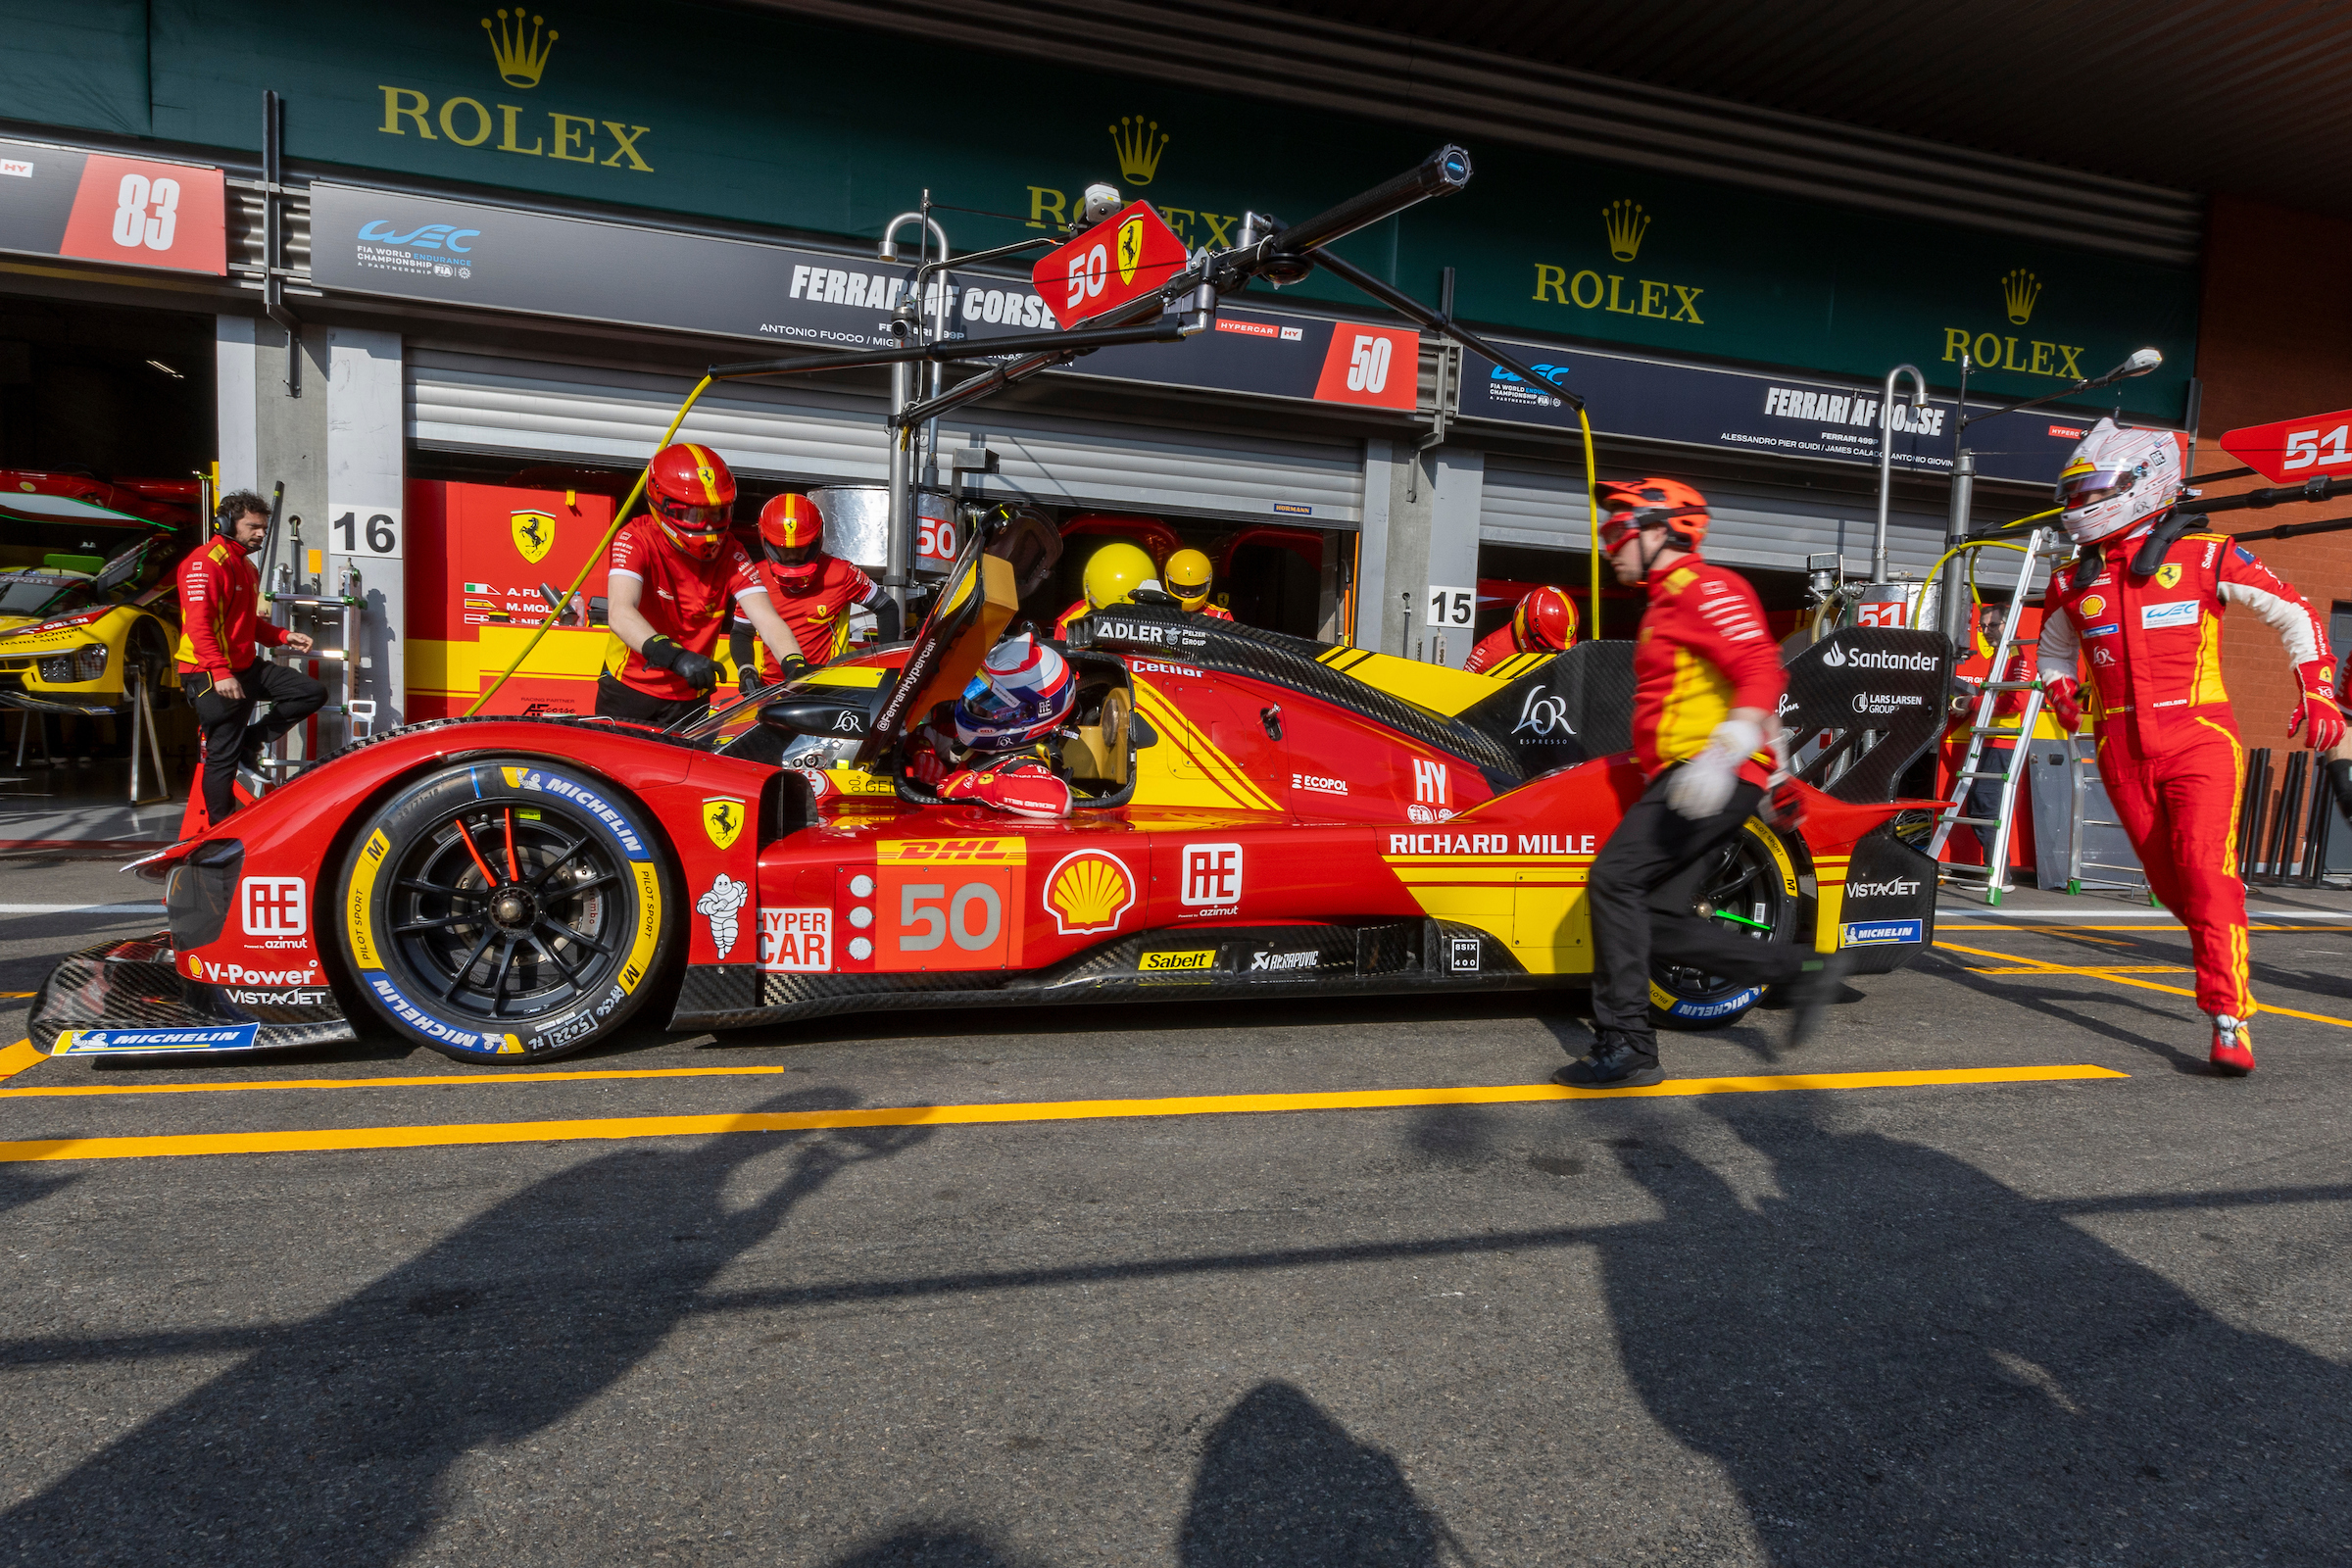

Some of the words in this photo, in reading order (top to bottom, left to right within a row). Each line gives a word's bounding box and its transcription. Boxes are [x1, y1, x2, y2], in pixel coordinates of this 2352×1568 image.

[378, 84, 655, 172] ROLEX
[4, 163, 27, 172] HY
[112, 173, 180, 251] 83
[1025, 185, 1239, 253] REX
[357, 220, 481, 253] WEC
[357, 245, 373, 254] FIA
[375, 247, 412, 259] WORLD
[413, 253, 471, 267] ENDURANCE
[357, 253, 432, 269] CHAMPIONSHIP
[368, 263, 432, 274] PARTNERSHIP
[1066, 243, 1107, 310] 50
[1532, 263, 1705, 324] ROLEX
[924, 282, 960, 318] AF
[962, 287, 1056, 330] CORSE
[760, 323, 817, 338] ANTONIO
[820, 330, 864, 343] FUOCO
[878, 322, 933, 337] FEARI
[1220, 321, 1274, 335] HYPERCAR
[1347, 334, 1393, 394] 50
[1941, 327, 2085, 380] ROLEX
[1490, 389, 1538, 400] CHAMPIONSHIP
[1502, 384, 1525, 393] WORLD
[1764, 387, 1851, 424] FERRARI
[1849, 396, 1879, 427] AF
[1821, 432, 1857, 444] FERRARI
[1857, 436, 1879, 446] 499P
[2051, 428, 2080, 437] HYPERC
[1721, 432, 1777, 447] ALESSANDRO
[1778, 439, 1797, 449] PIER
[1797, 440, 1821, 451] GUIDI
[1825, 444, 1852, 455] JAMES
[1890, 453, 1927, 464] ANTONIO
[1927, 458, 1954, 467] GIOVIN
[2283, 424, 2352, 470] 51
[333, 512, 396, 554] 16
[916, 518, 956, 559] 50
[507, 587, 521, 597] A.
[506, 602, 521, 612] M.
[523, 604, 554, 613] MOL
[1432, 591, 1472, 624] 15
[1858, 604, 1902, 629] 51
[2146, 603, 2196, 618] WEC
[43, 617, 89, 630] ORLEN
[1097, 621, 1163, 643] ADLER
[1182, 629, 1206, 638] PELZER
[1132, 660, 1204, 678] Cetilar
[1847, 648, 1938, 672] Santander
[875, 637, 937, 731] @FerrariHypercar
[1775, 693, 1799, 718] -Ban
[1869, 704, 1895, 714] GROUP
[1870, 694, 1890, 705] LARS
[1891, 694, 1923, 706] LARSEN
[1303, 775, 1348, 792] ECOPOL
[1412, 759, 1446, 805] HY
[546, 777, 643, 853] MICHELIN
[1390, 834, 1509, 855] RICHARD
[1518, 834, 1595, 855] MILLE
[1748, 819, 1768, 835] PILOT
[1767, 835, 1785, 857] SPORT
[367, 838, 385, 861] M
[898, 840, 1009, 860] DHL
[641, 871, 654, 901] PILOT
[1786, 878, 1796, 891] M
[1846, 875, 1921, 899] VISTAJET
[645, 904, 655, 938] SPORT
[899, 882, 1002, 952] 50
[1199, 904, 1239, 917] azimut
[757, 912, 826, 932] HYPER
[1857, 926, 1914, 939] MICHELIN
[265, 936, 308, 950] azimut
[356, 929, 370, 959] PILOT
[757, 933, 826, 965] CAR
[1454, 943, 1477, 952] 8SIX
[1147, 953, 1207, 969] Sabelt
[1454, 958, 1476, 967] 400
[204, 960, 316, 985] V-Power
[622, 962, 642, 987] M
[224, 988, 326, 1005] VISTAJET
[1650, 989, 1669, 1004] PILOT
[1678, 991, 1750, 1017] MICHELIN
[372, 980, 479, 1049] MICHELIN
[112, 1031, 242, 1046] MICHELIN
